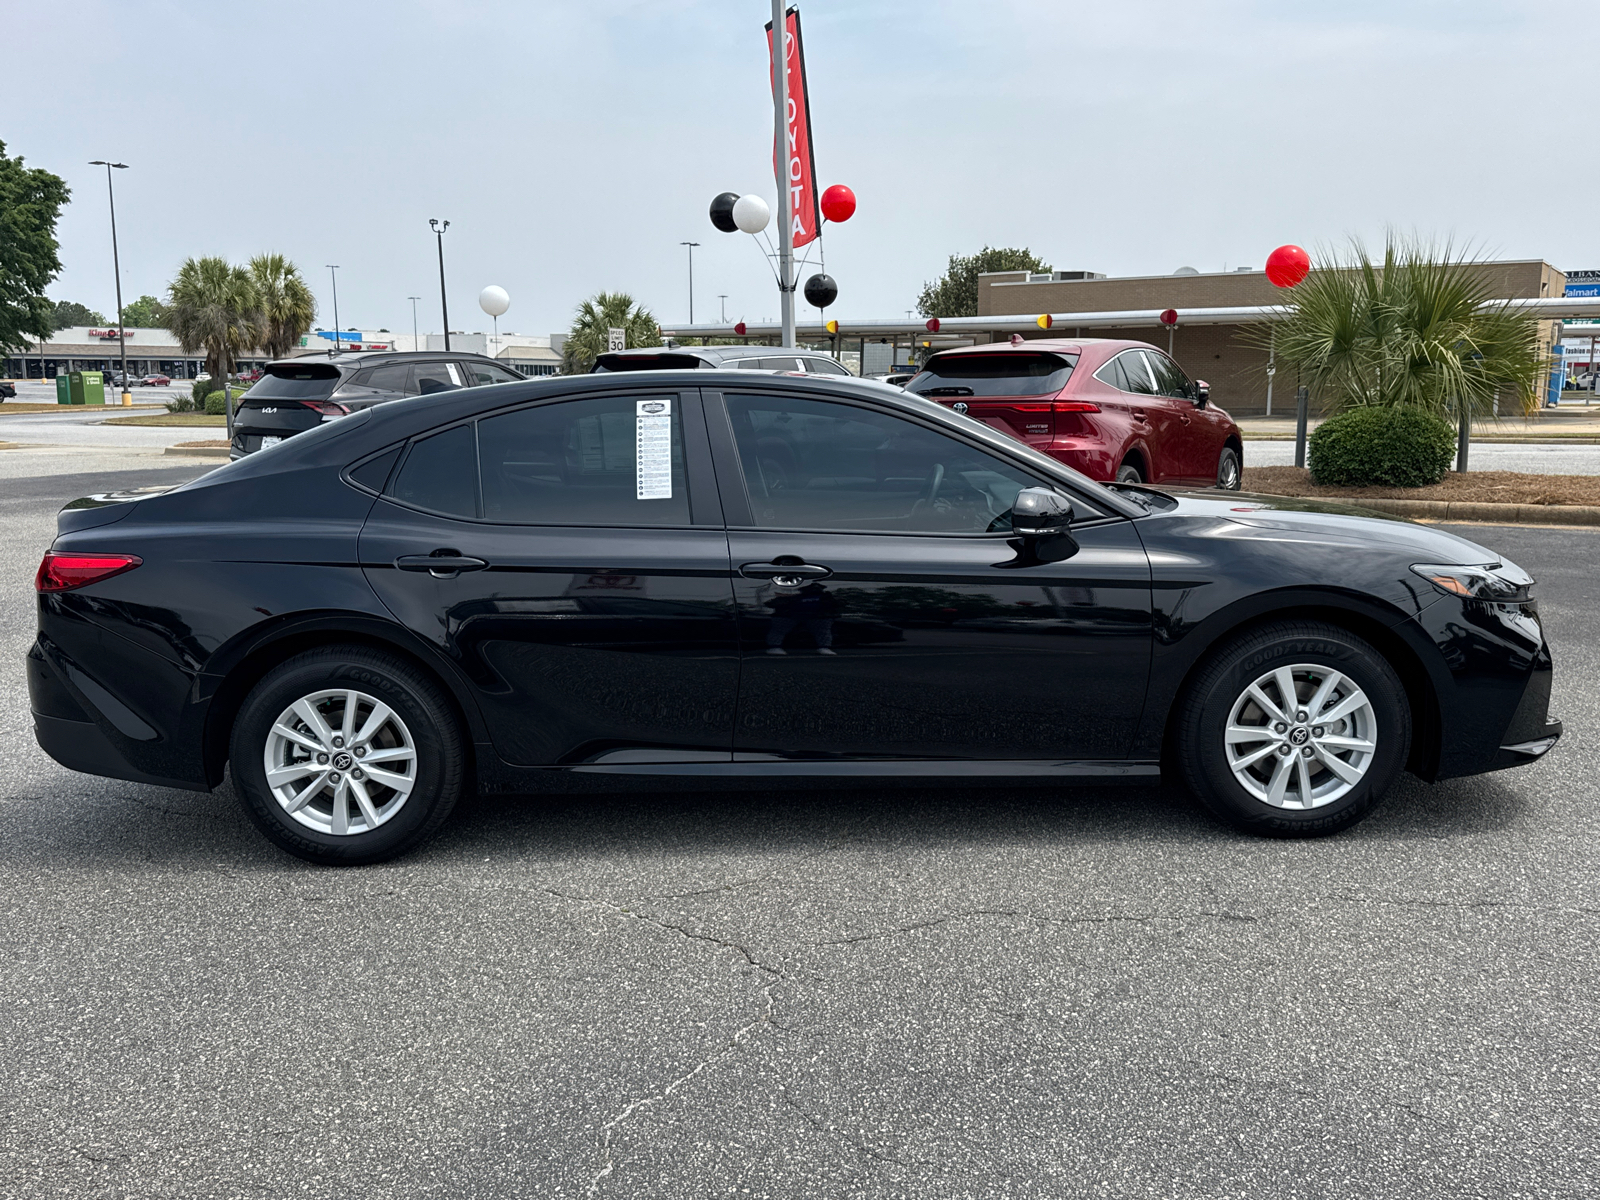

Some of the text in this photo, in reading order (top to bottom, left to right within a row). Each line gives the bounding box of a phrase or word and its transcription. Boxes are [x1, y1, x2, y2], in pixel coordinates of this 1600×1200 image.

[610, 341, 624, 351] 30
[1244, 641, 1338, 672] GOODYEAR
[349, 668, 429, 728] GOODYEAR
